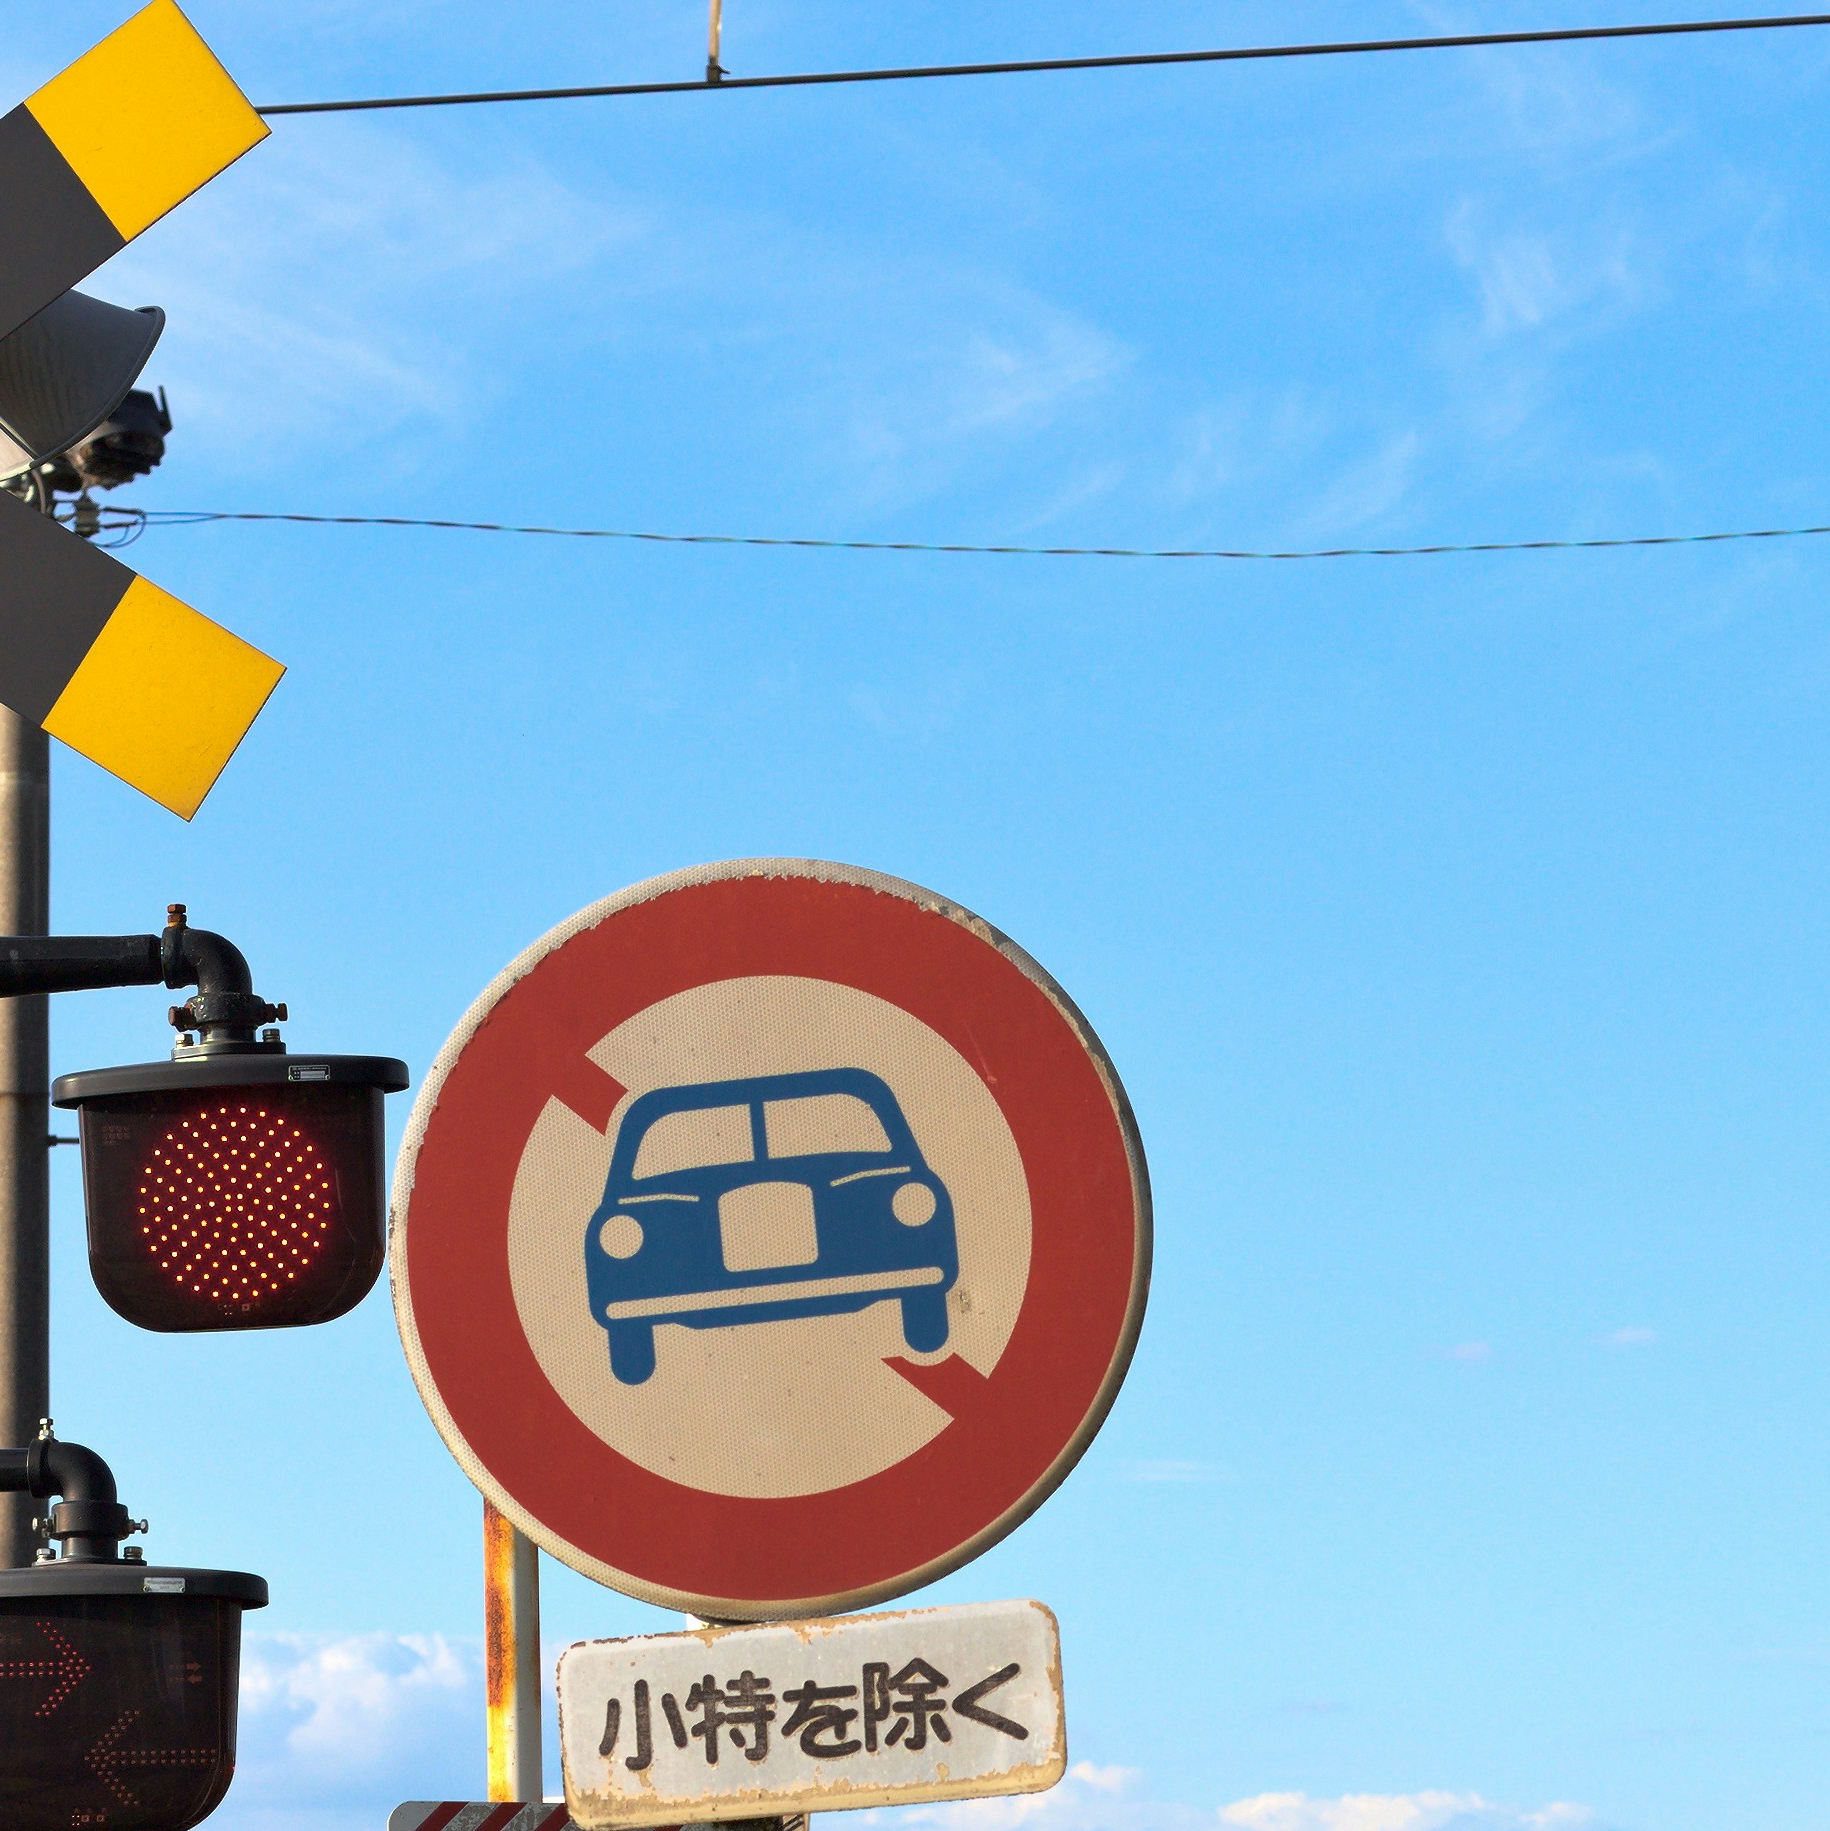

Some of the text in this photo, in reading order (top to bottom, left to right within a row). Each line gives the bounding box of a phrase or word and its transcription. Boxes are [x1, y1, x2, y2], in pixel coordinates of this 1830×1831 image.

[599, 1657, 1029, 1771] 小特を除く
